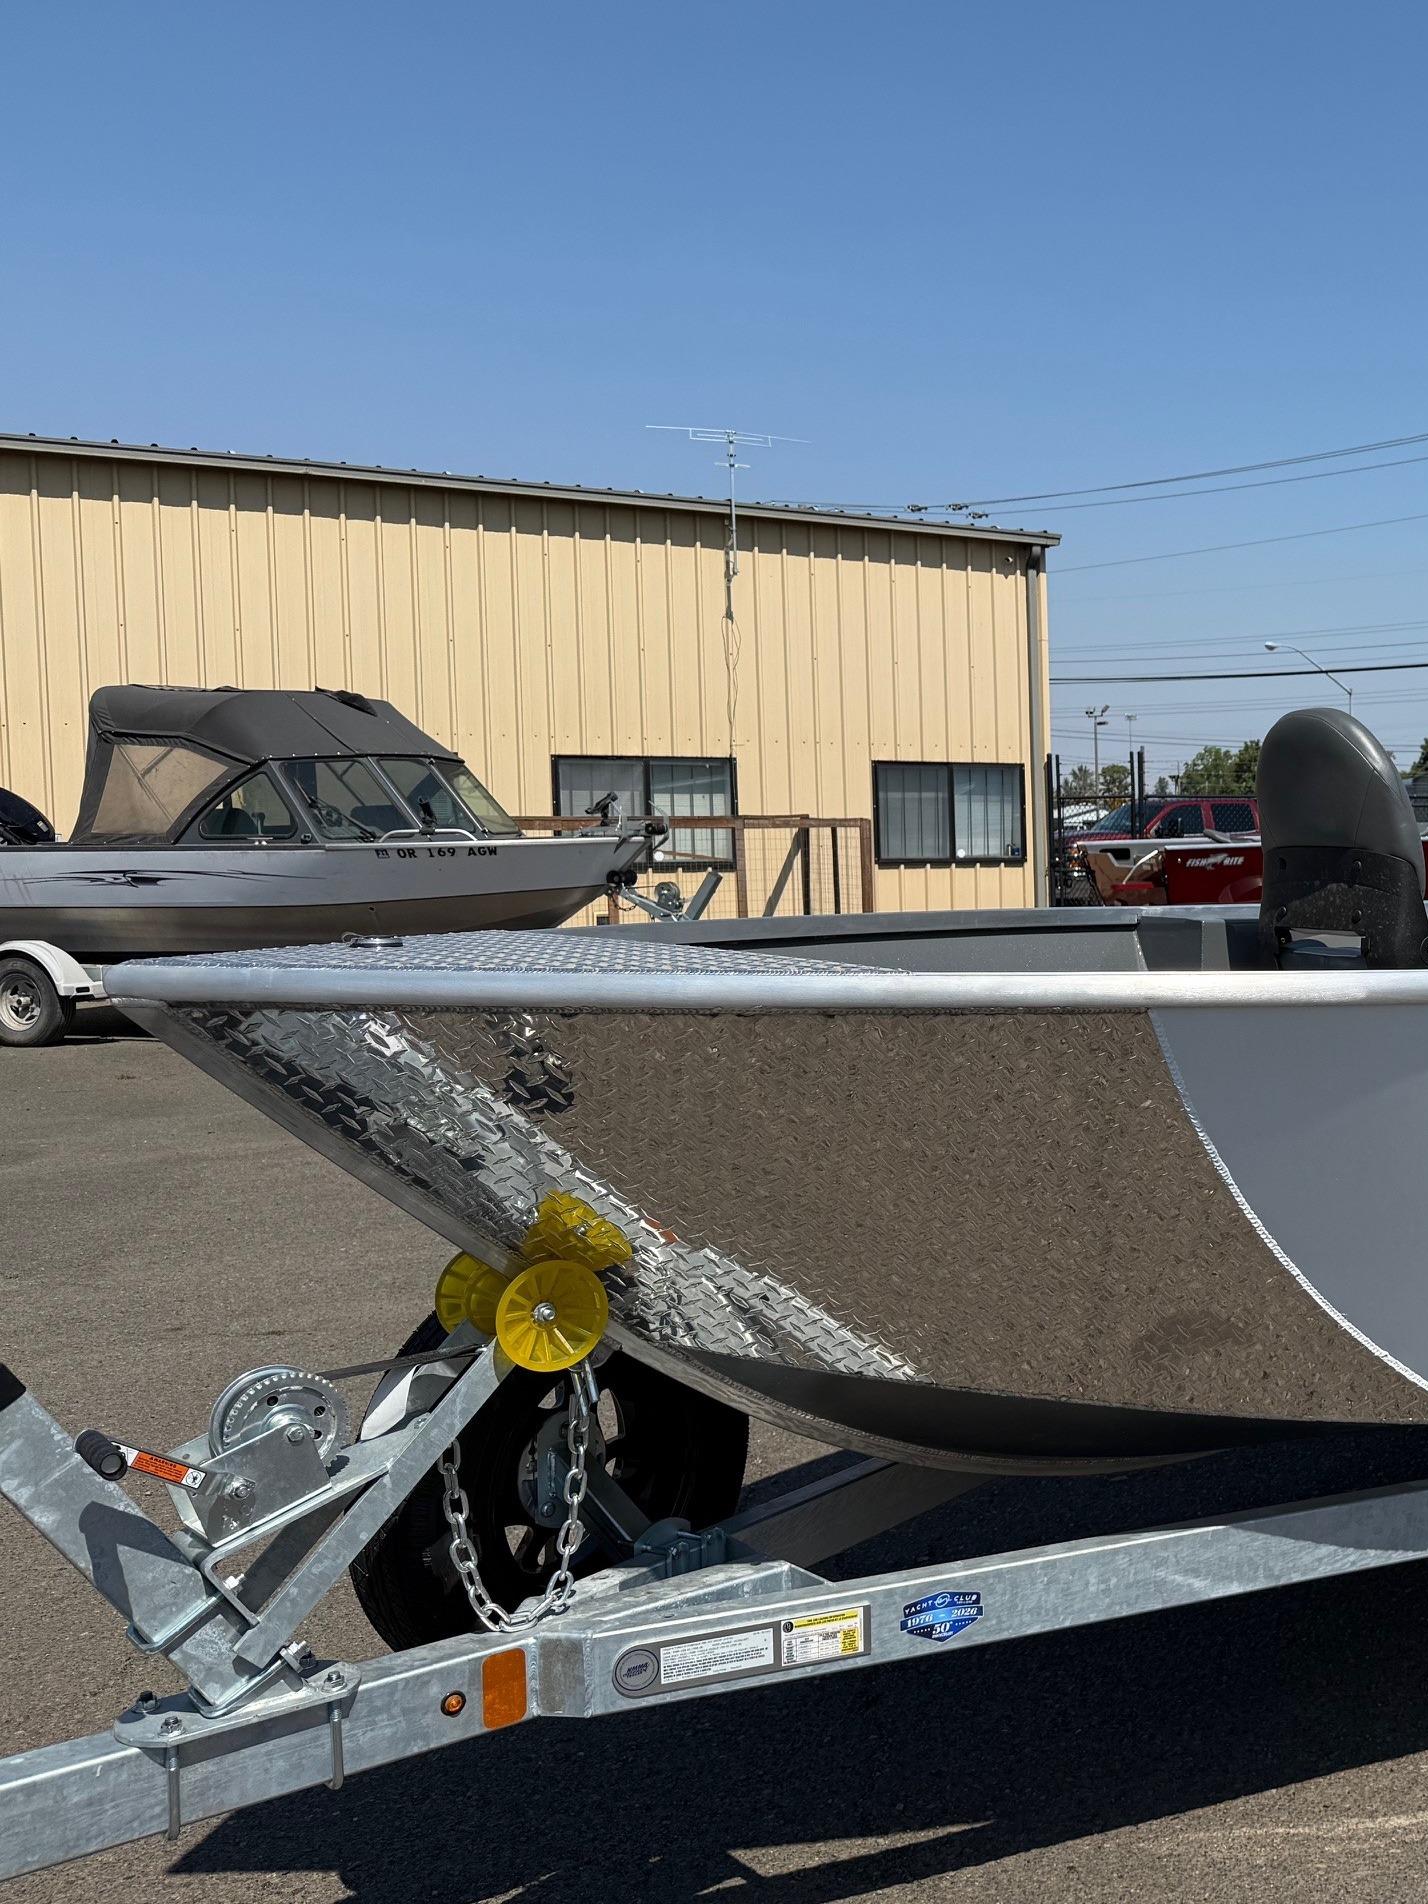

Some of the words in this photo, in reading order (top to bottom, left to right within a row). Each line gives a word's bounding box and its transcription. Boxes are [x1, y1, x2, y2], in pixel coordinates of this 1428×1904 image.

[396, 848, 417, 859] OR
[426, 847, 456, 858] 169
[467, 846, 498, 857] AGW
[1185, 858, 1208, 868] FISH
[1223, 856, 1245, 866] RITE
[905, 1600, 933, 1615] YACHT
[953, 1594, 978, 1602] CLUB
[907, 1614, 934, 1628] 1976
[951, 1607, 978, 1617] 2026
